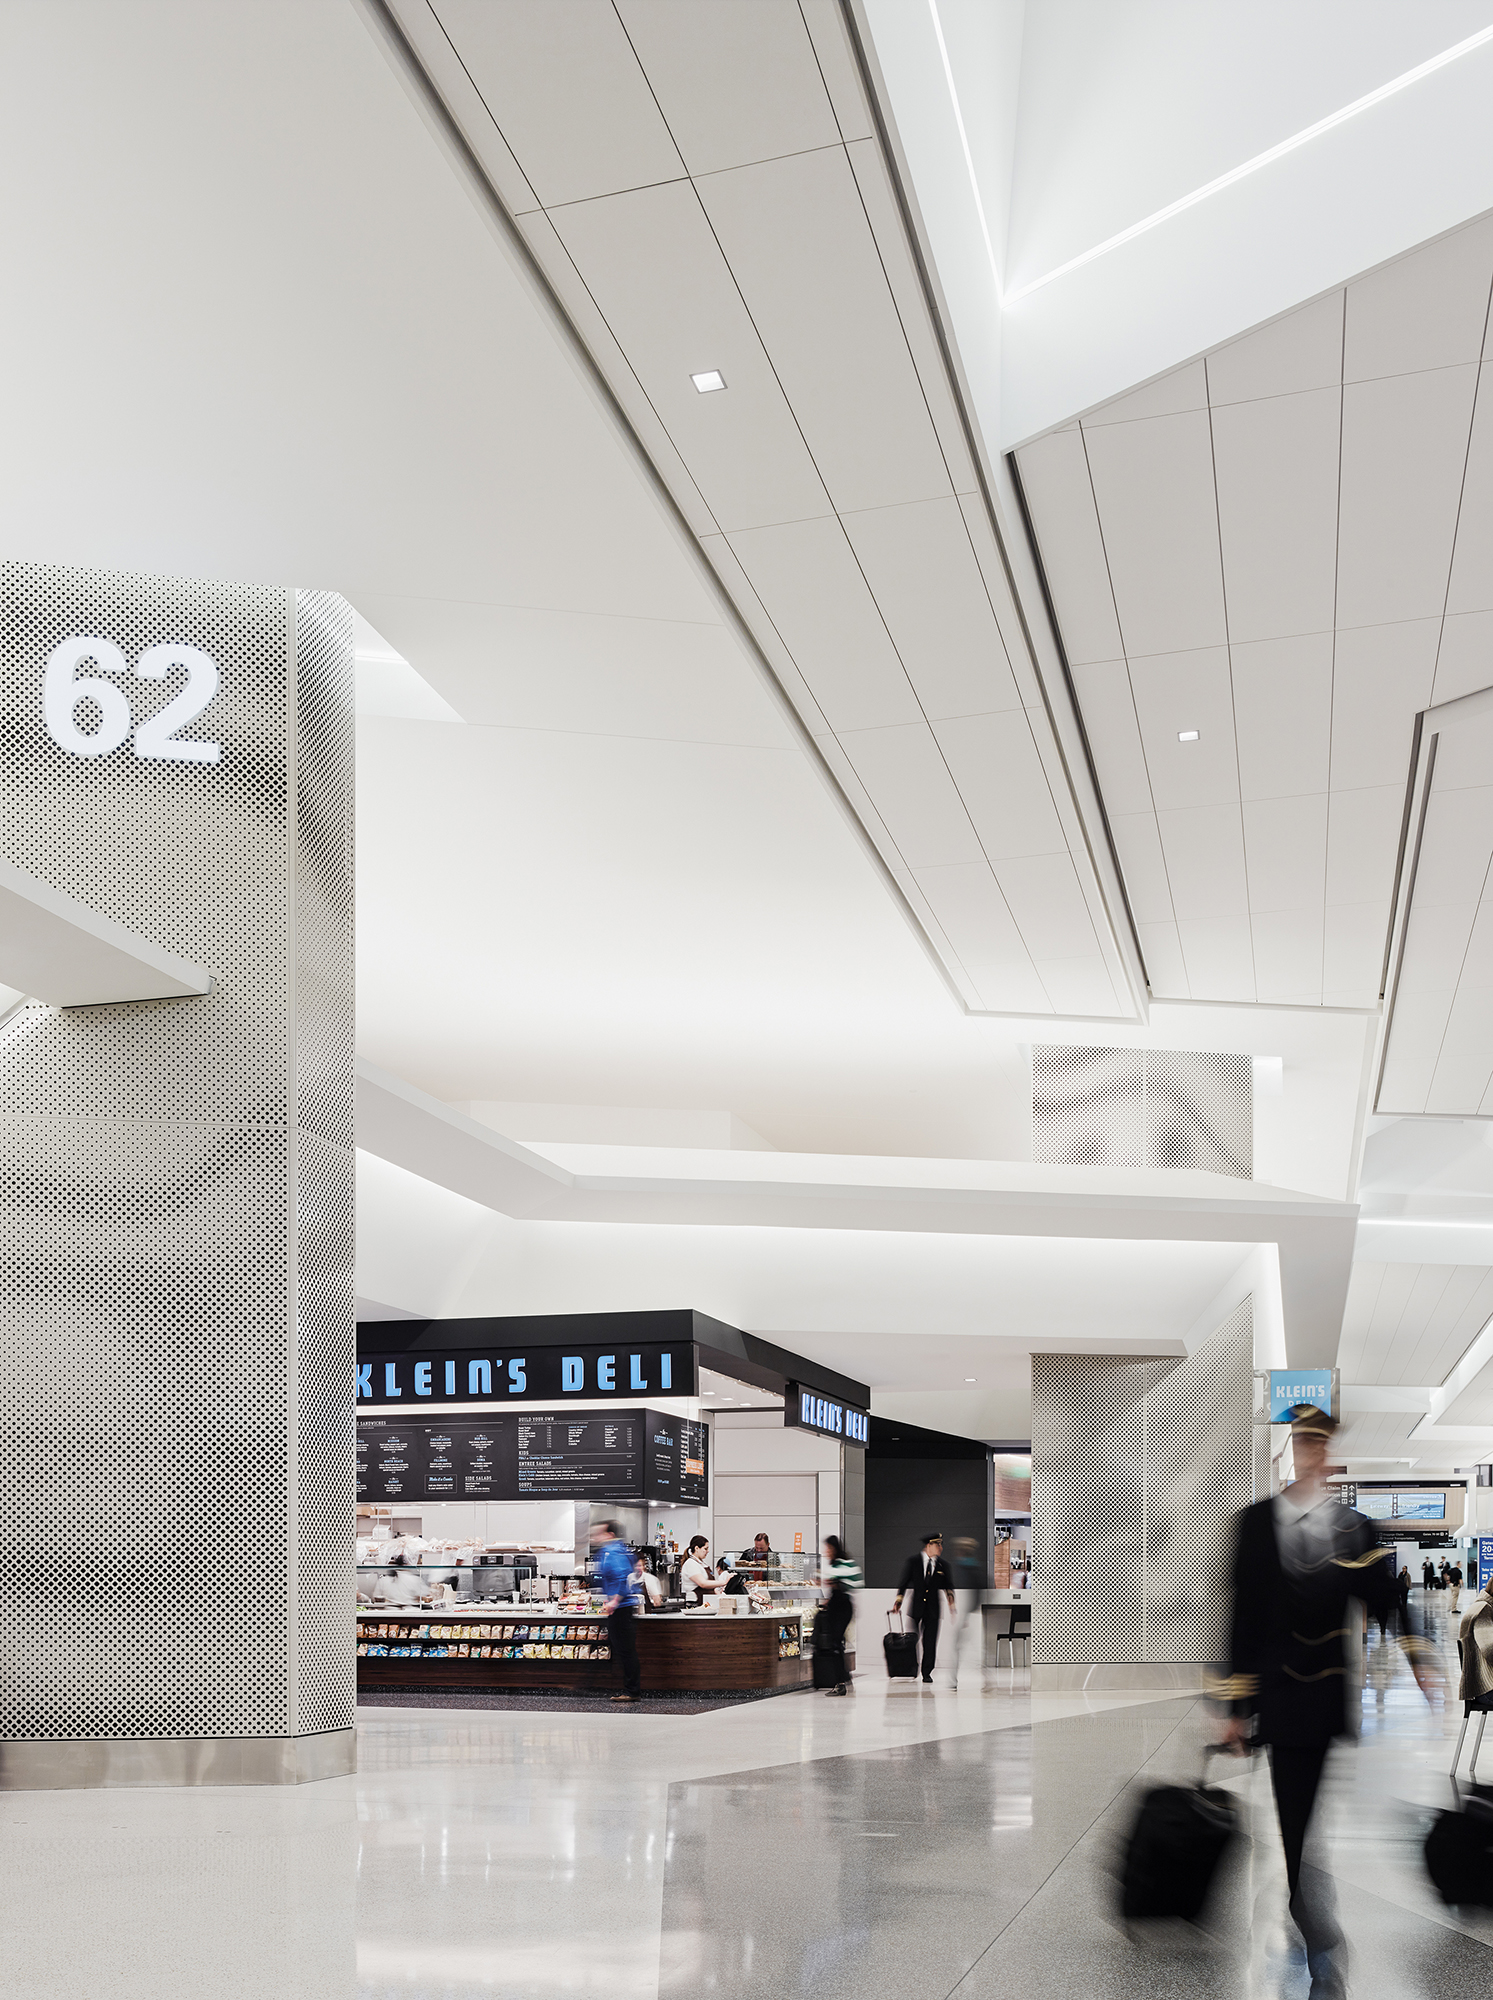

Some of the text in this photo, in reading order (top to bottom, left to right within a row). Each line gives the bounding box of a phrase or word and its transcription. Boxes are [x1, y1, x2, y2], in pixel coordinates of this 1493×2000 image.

[45, 636, 219, 762] 62
[356, 1353, 672, 1398] KLEIN'S DELI
[1276, 1385, 1325, 1398] KLEIN'S
[802, 1393, 868, 1442] KLEIN'S DELI
